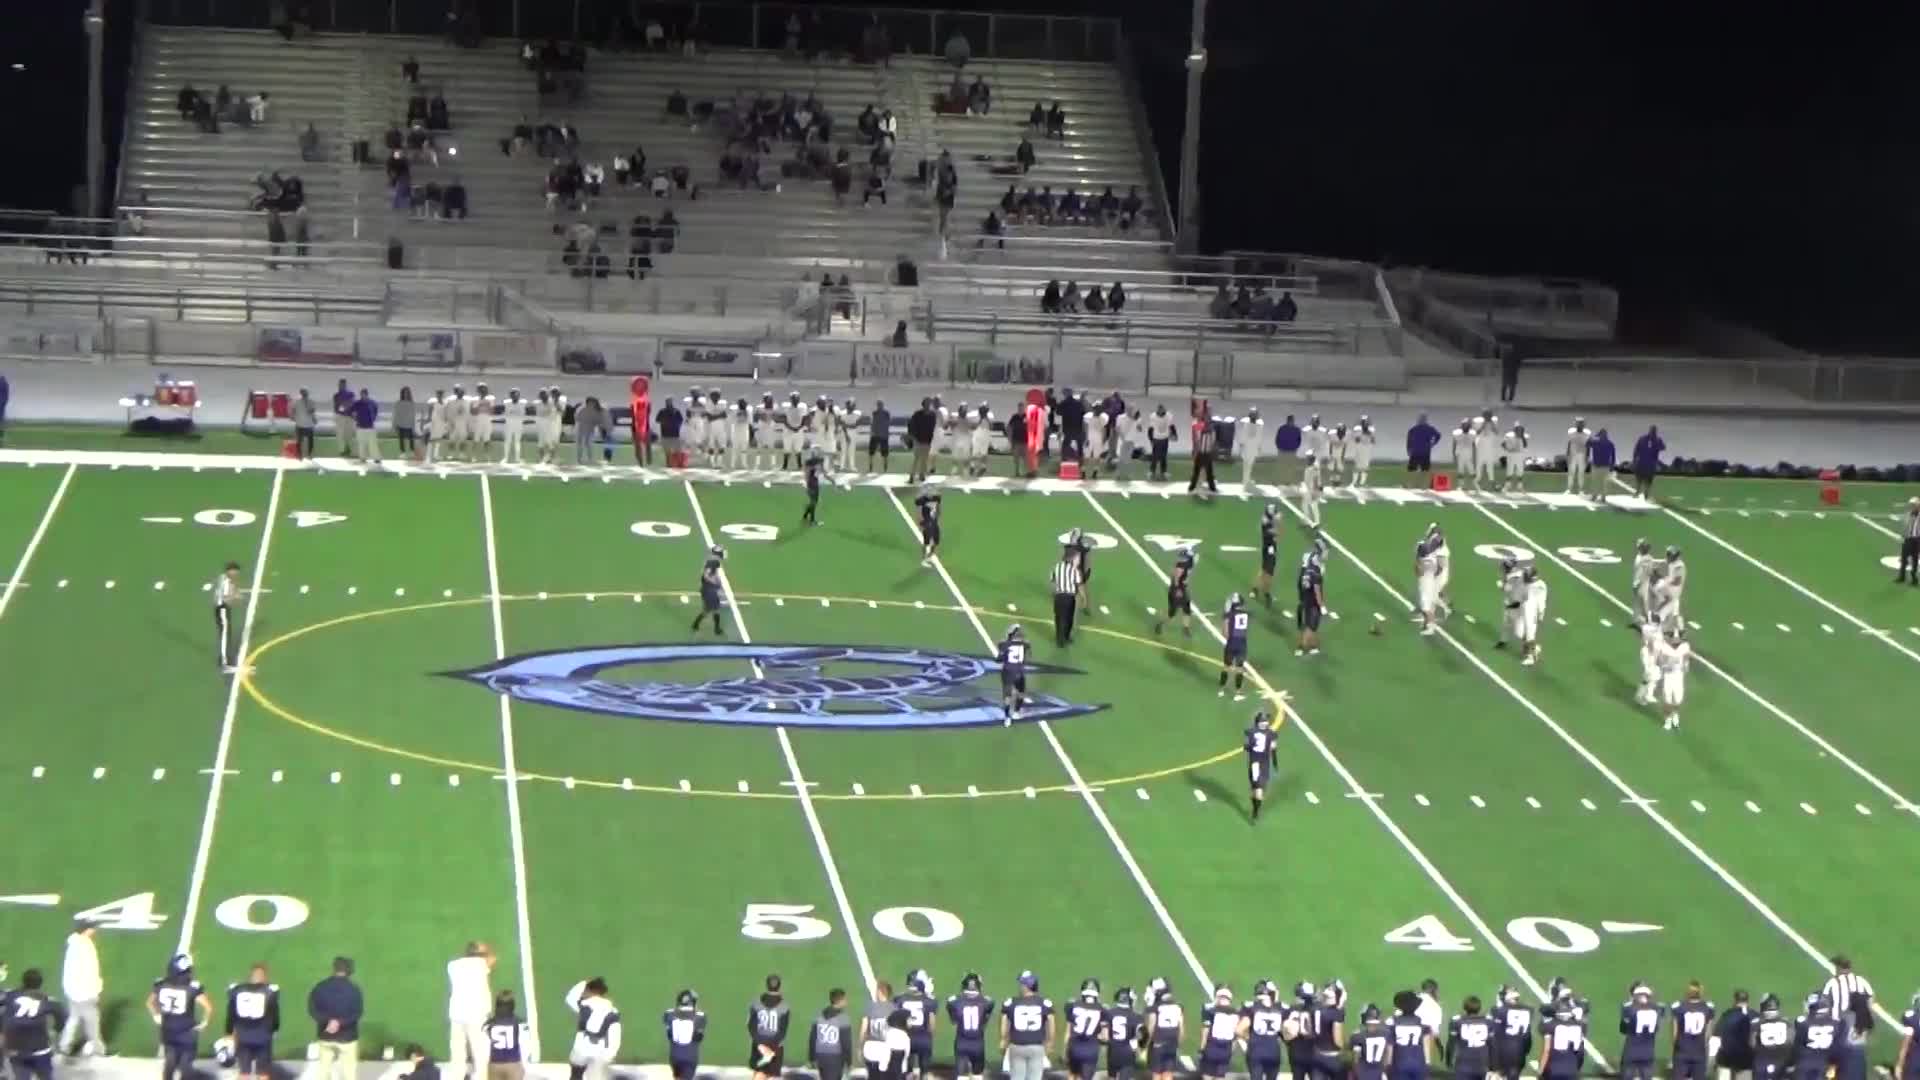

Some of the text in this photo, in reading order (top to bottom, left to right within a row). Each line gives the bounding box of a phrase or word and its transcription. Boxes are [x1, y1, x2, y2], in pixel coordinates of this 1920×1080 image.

[73, 892, 309, 931] 40
[741, 904, 964, 942] 50
[1384, 914, 1600, 953] 40
